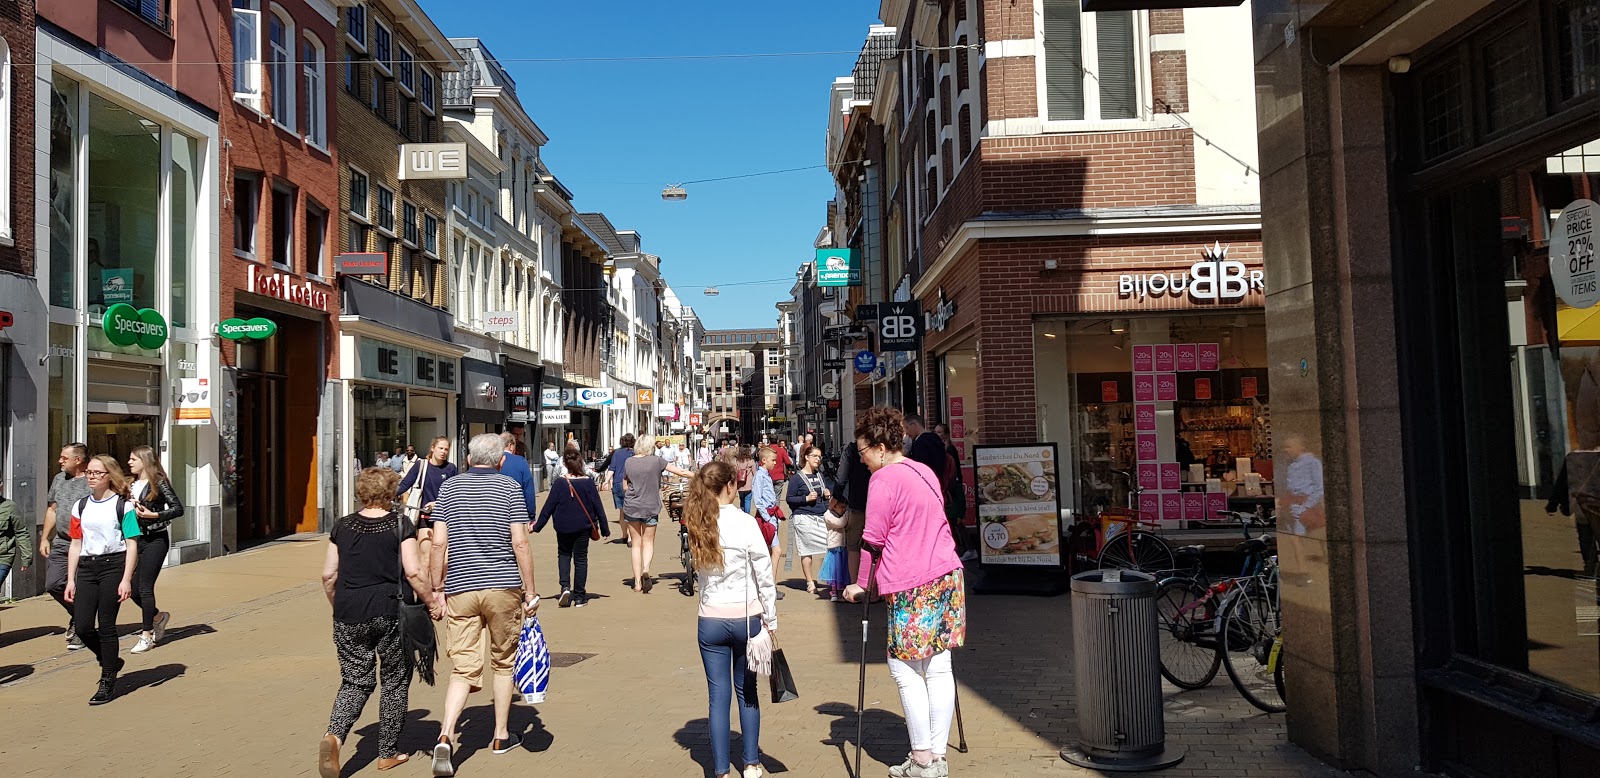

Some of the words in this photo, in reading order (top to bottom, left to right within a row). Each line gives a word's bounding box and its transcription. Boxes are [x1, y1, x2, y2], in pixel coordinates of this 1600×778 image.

[411, 149, 460, 173] WE
[1566, 208, 1591, 223] SPECIAL
[1566, 218, 1592, 235] PRICE
[1568, 235, 1593, 256] 20%
[1569, 255, 1594, 274] OFF
[1119, 272, 1187, 297] BIJOU
[1571, 281, 1596, 296] ITEMS
[114, 314, 164, 337] Specsavers
[222, 324, 268, 334] Specsavers
[487, 316, 514, 326] steps
[377, 347, 398, 375] WE
[417, 356, 434, 382] WE
[439, 360, 454, 385] WE
[581, 389, 608, 400] etos
[1185, 499, 1202, 507] -20%
